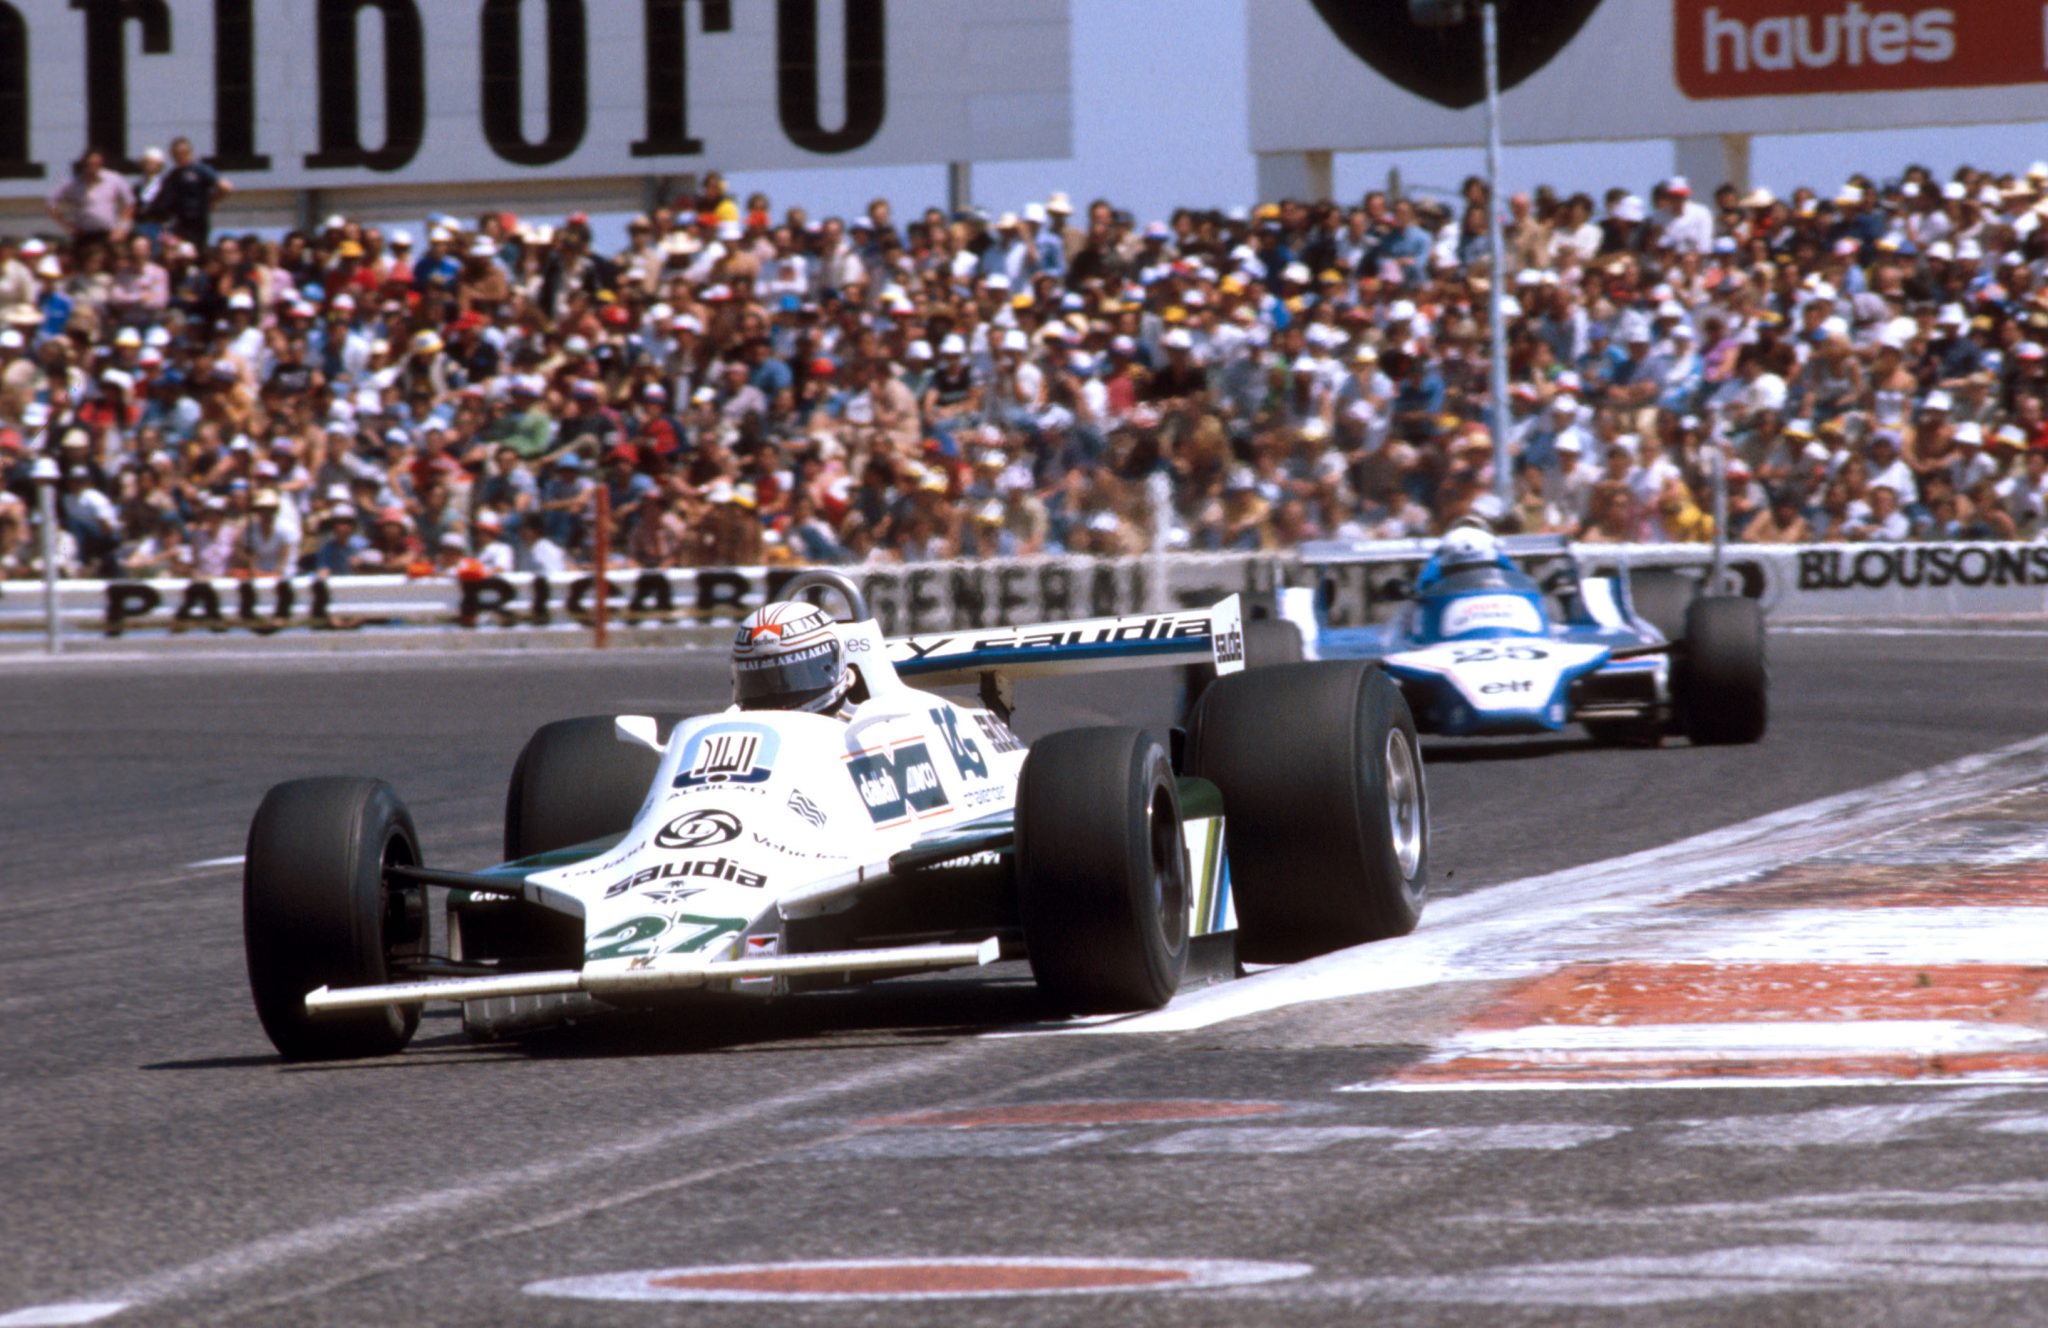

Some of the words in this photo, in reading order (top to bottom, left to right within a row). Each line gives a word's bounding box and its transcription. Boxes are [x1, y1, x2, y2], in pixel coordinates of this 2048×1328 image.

[1703, 3, 1957, 74] hautes
[1797, 547, 2048, 590] BLOUSONS
[777, 651, 807, 666] AKAI
[809, 642, 832, 659] AKAI
[1479, 680, 1533, 694] elf
[667, 784, 767, 801] ALBILAD
[604, 857, 768, 899] saudia
[585, 913, 748, 962] 27
